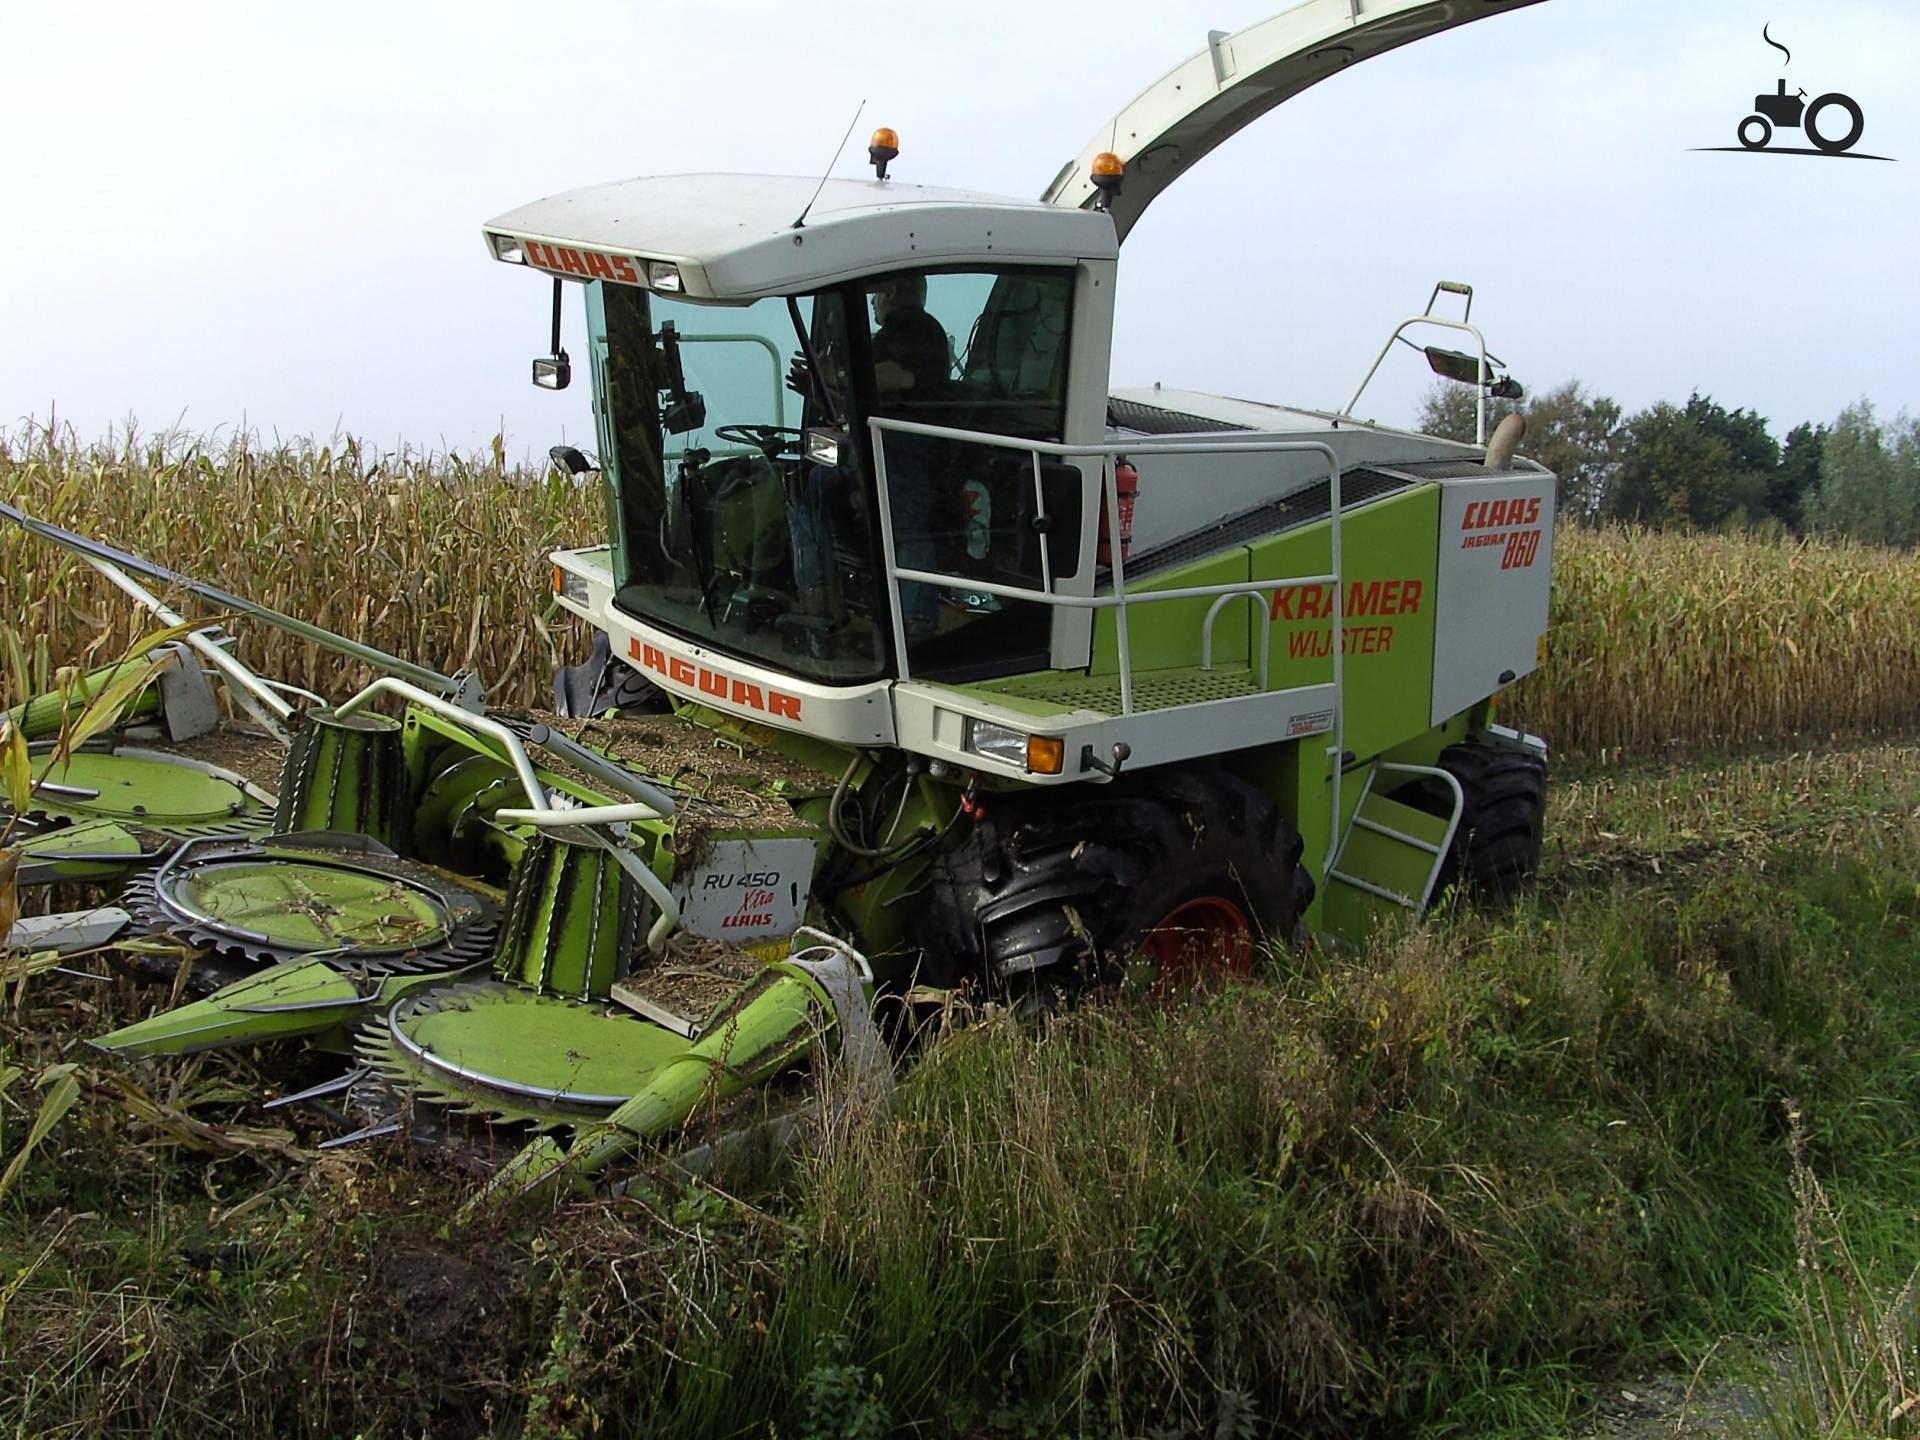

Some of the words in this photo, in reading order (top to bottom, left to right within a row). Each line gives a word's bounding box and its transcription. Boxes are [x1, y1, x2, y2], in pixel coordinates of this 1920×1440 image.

[525, 240, 638, 283] CLAAS
[1461, 497, 1541, 530] CLAAS
[1461, 533, 1505, 549] JAGUAR
[1502, 530, 1541, 570] 860
[1270, 580, 1422, 621] KRAMER
[628, 637, 802, 722] JAGUAR
[703, 874, 735, 890] RU
[737, 871, 780, 887] 450
[737, 888, 774, 914] Xtra
[722, 913, 773, 929] CLAAS
